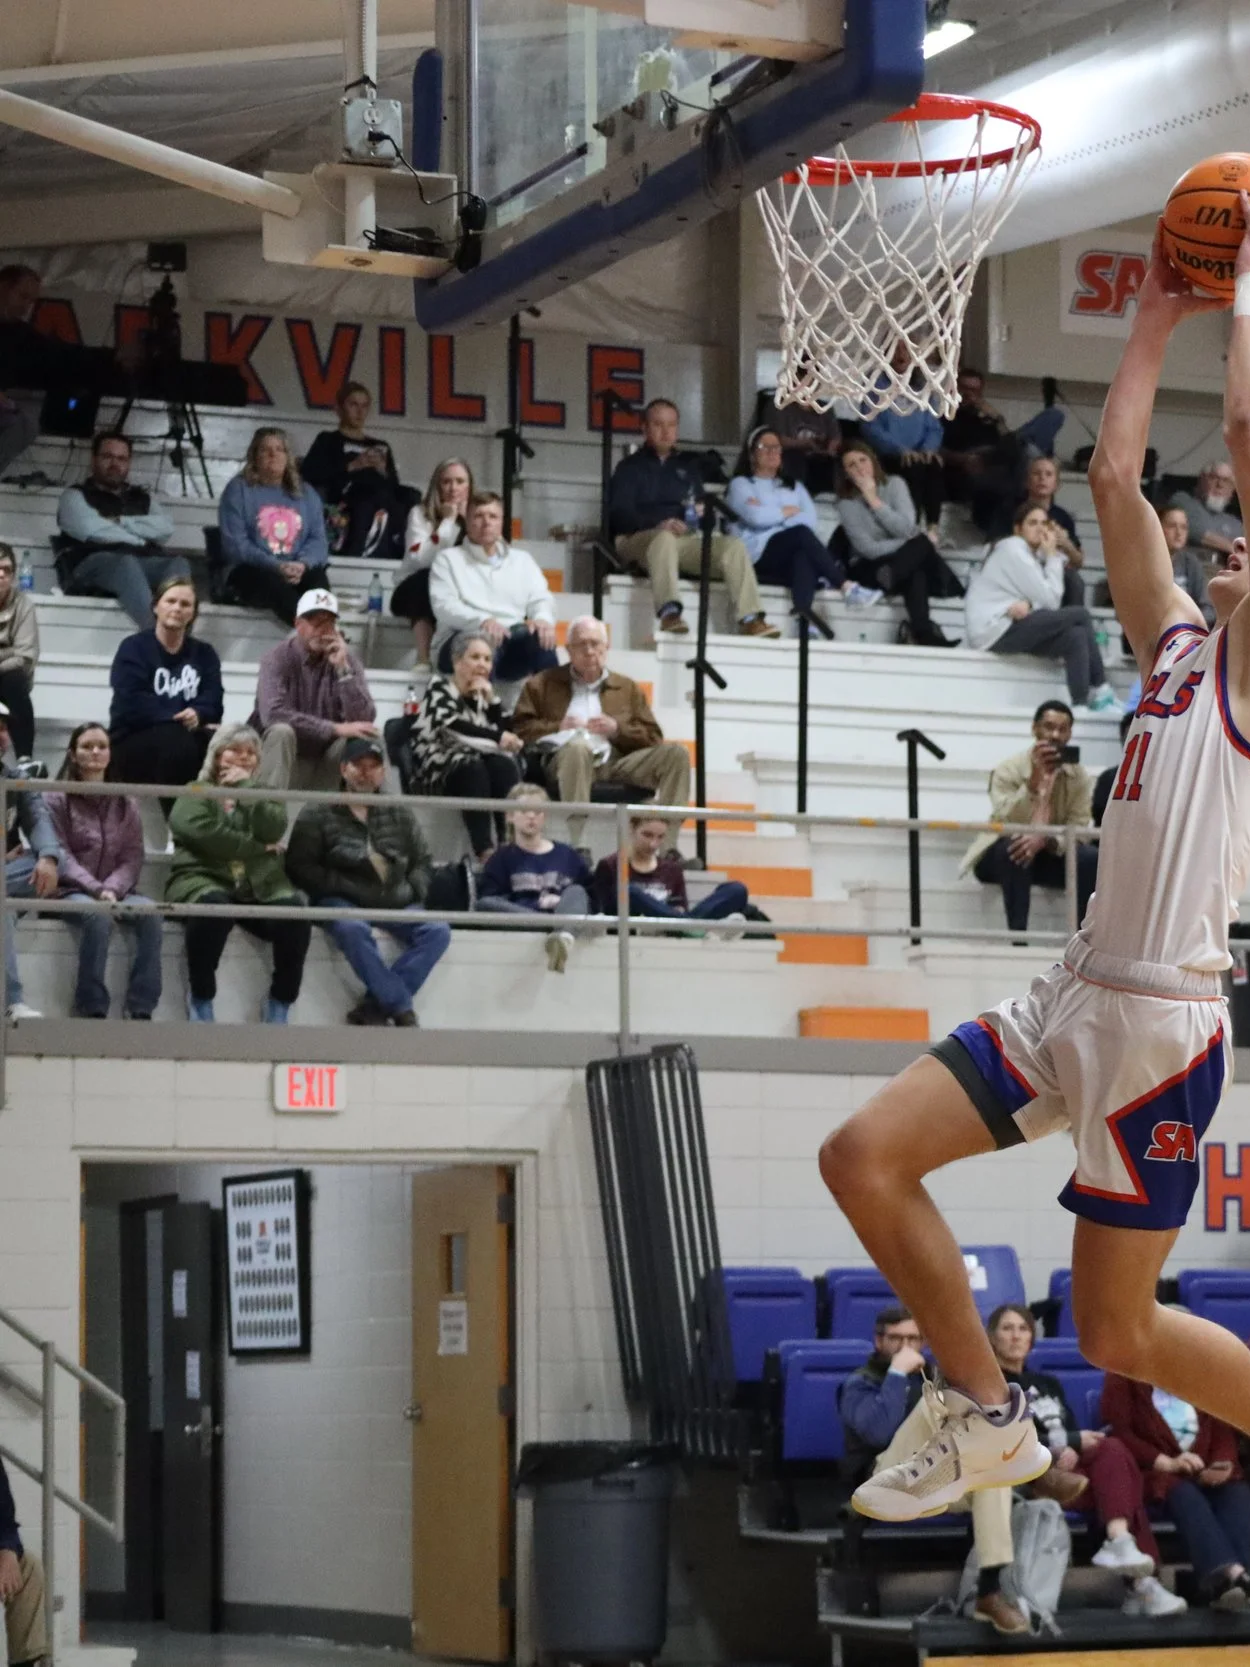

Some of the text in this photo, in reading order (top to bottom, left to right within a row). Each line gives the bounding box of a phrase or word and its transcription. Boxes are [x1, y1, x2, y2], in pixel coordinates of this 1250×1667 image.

[1068, 250, 1149, 317] SA
[1175, 246, 1236, 281] ilson
[1112, 731, 1152, 801] 11
[287, 1066, 338, 1107] EXIT
[1144, 1120, 1197, 1163] SA
